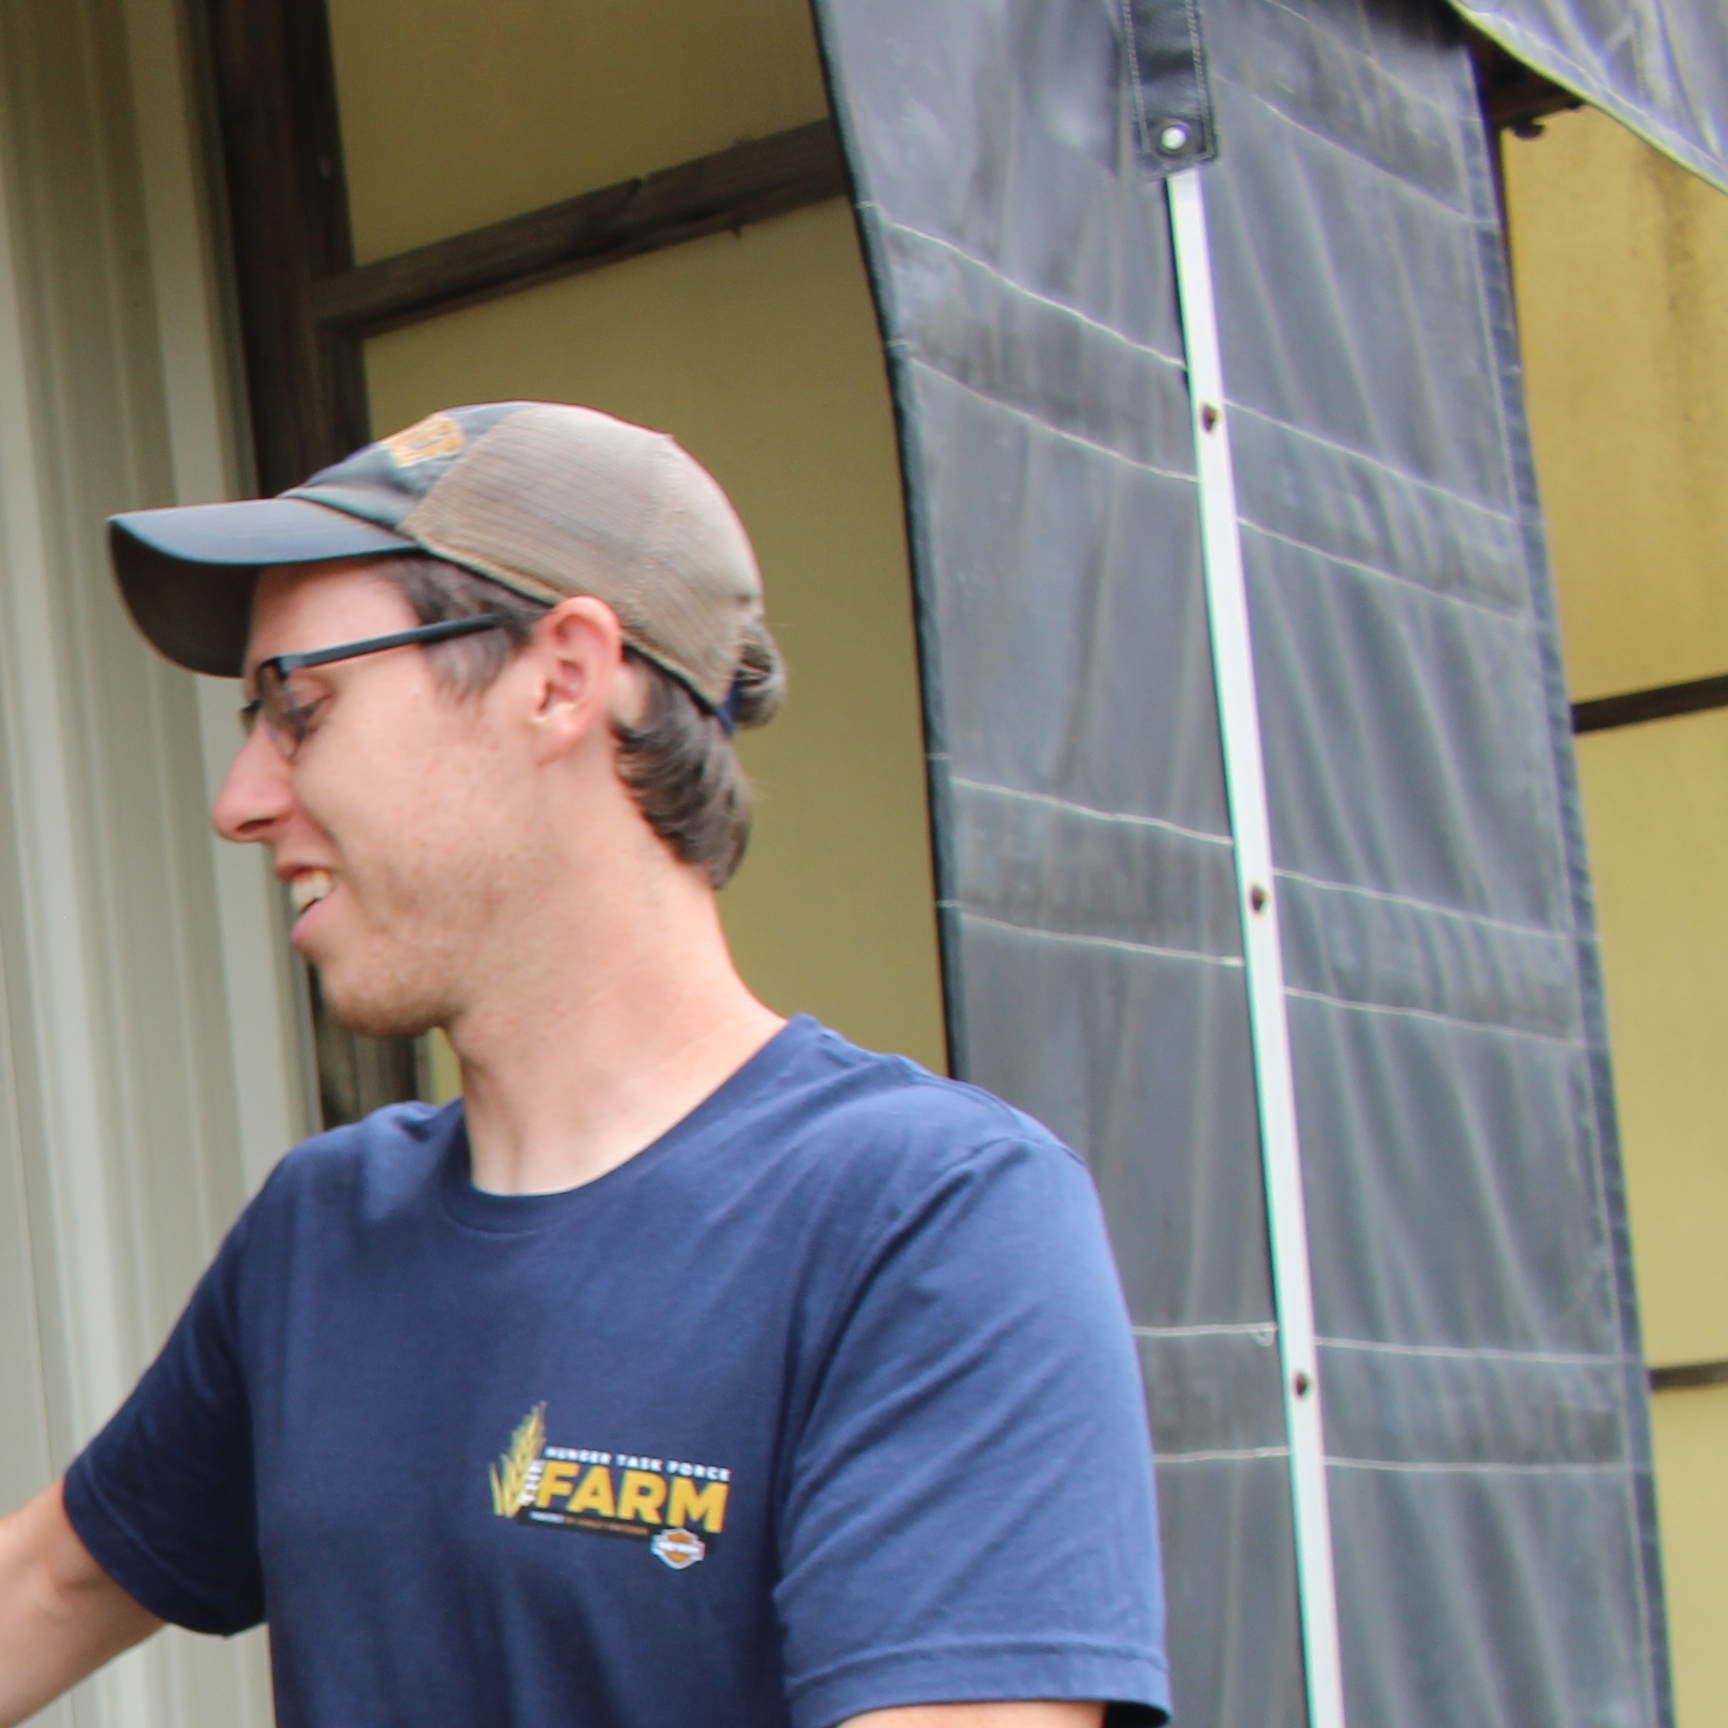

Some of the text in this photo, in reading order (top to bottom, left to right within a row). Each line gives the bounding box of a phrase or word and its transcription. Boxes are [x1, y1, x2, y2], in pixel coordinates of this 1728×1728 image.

[615, 1453, 663, 1472] TASK
[666, 1459, 732, 1482] FORCE
[535, 1461, 730, 1533] FARM
